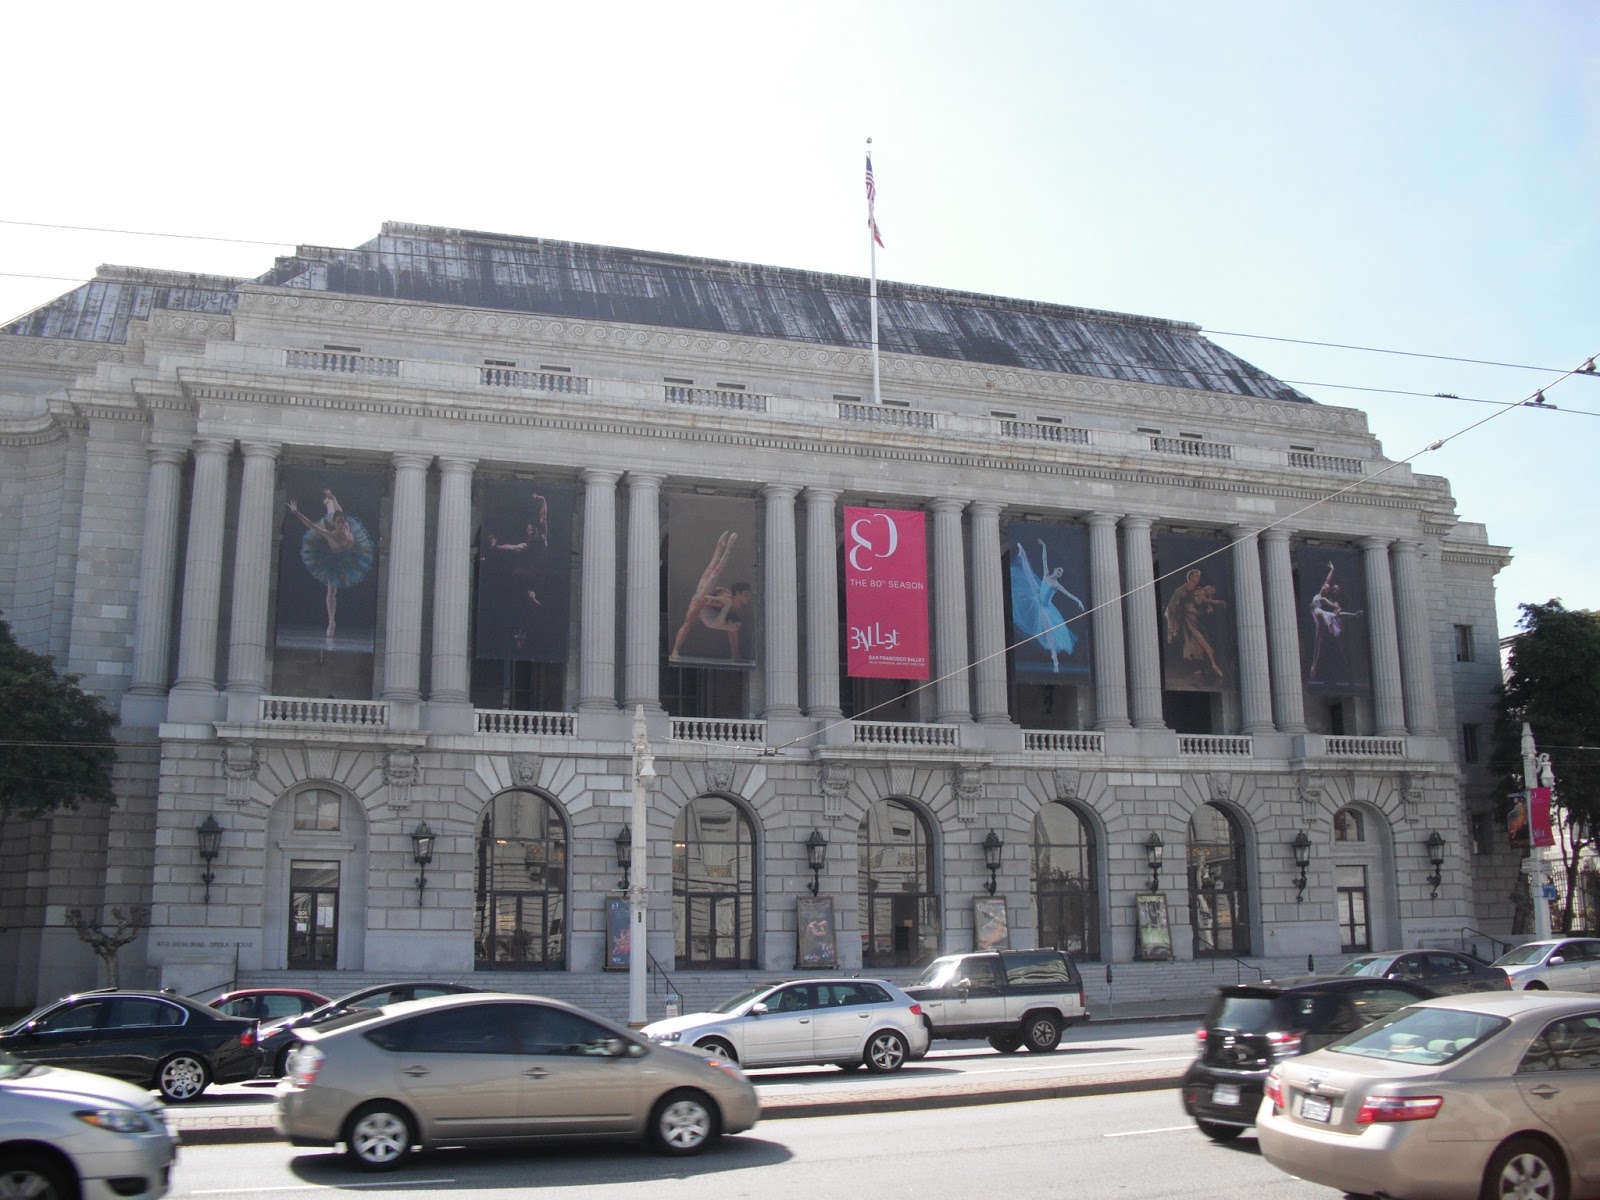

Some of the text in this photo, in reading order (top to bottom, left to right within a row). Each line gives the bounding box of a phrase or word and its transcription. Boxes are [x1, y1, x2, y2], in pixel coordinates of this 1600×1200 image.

[849, 513, 898, 571] 80
[850, 578, 867, 587] THE
[888, 580, 924, 590] SEASON
